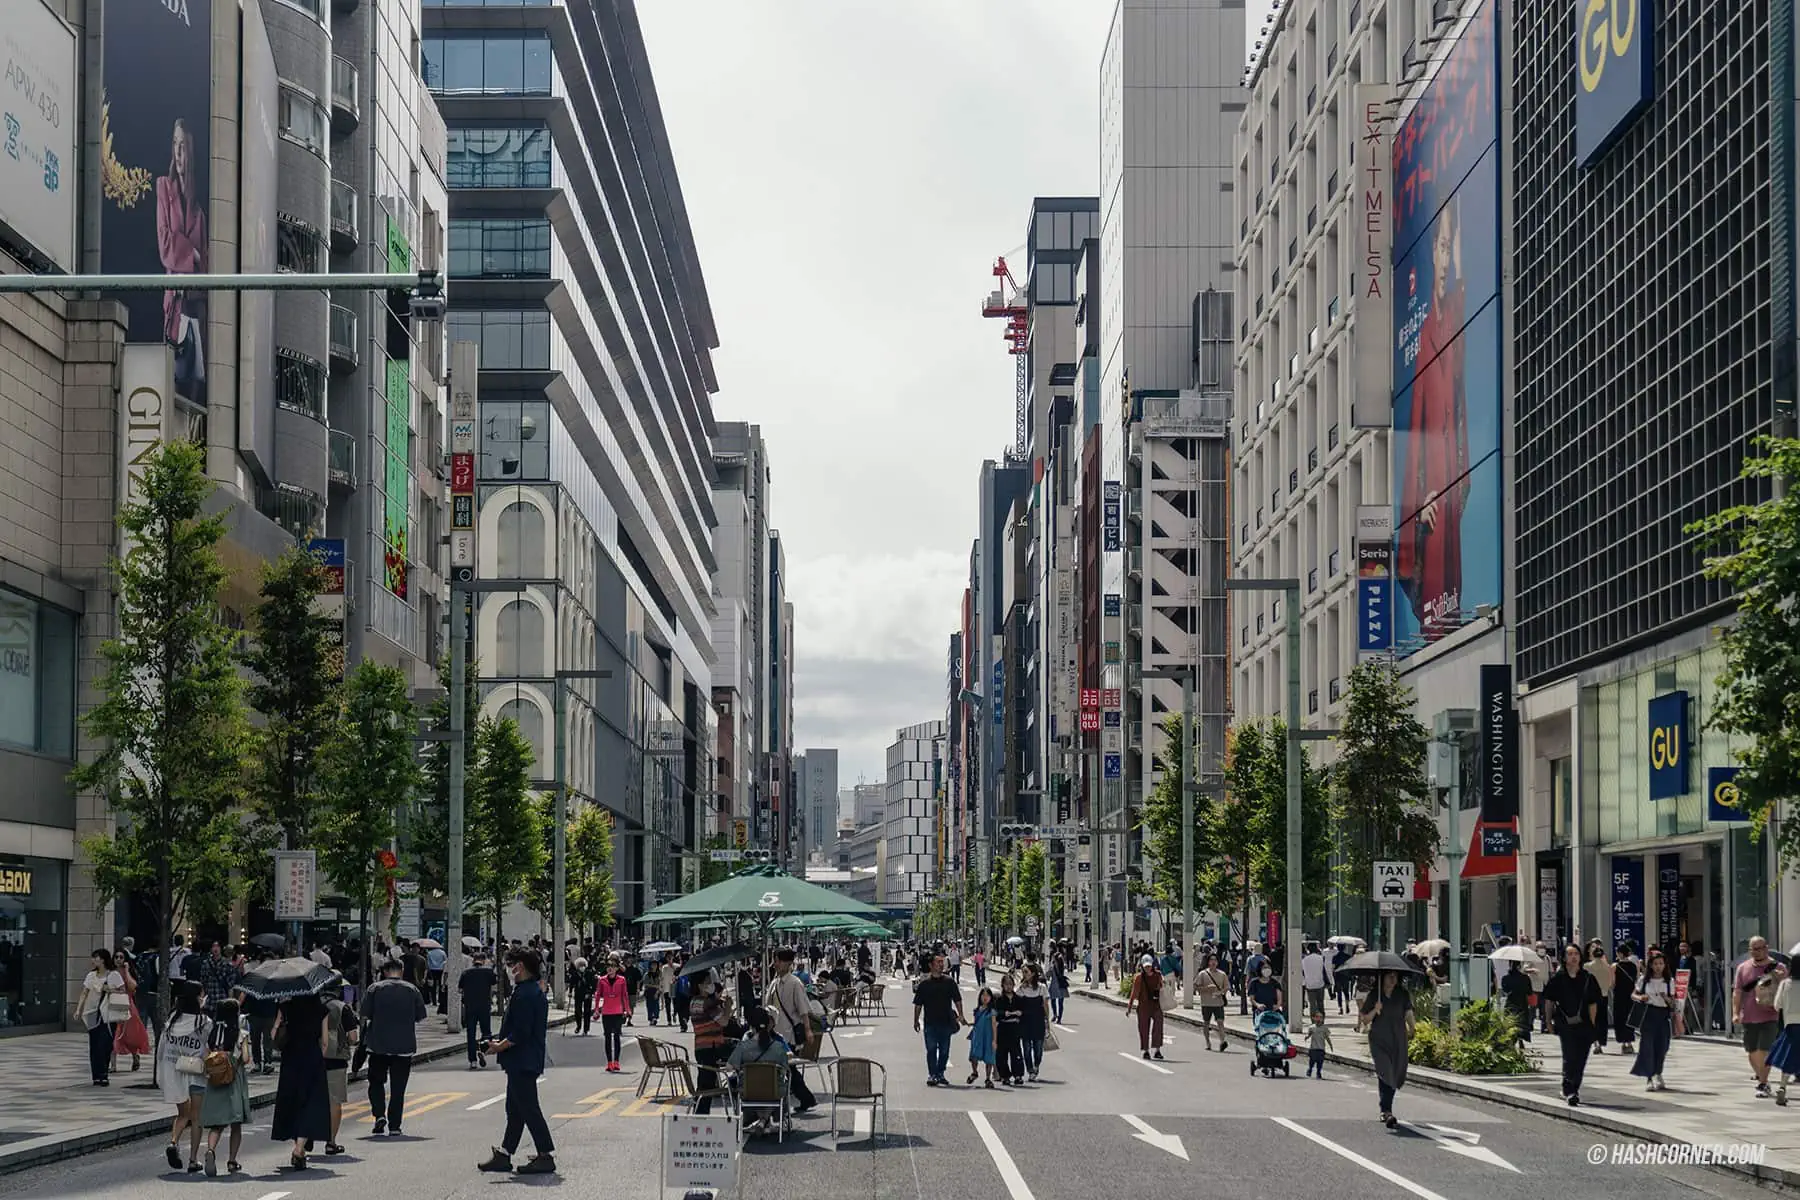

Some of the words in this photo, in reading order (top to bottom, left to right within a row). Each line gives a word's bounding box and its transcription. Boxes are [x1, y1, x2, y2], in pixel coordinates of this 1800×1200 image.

[1580, 0, 1636, 93] GU
[38, 92, 60, 129] 430
[1366, 103, 1382, 299] EXITMELSA
[456, 455, 470, 486] まつげ
[456, 497, 469, 527] 歯科
[1360, 549, 1389, 559] Seria
[1368, 586, 1382, 644] PLAZA
[1432, 586, 1459, 618] SoftBank
[1491, 691, 1504, 796] WASHINGTON
[1651, 724, 1679, 770] GU
[1484, 837, 1513, 845] ワシントン
[1378, 866, 1409, 876] TAXI
[1614, 872, 1630, 885] 5F
[1614, 900, 1630, 913] 4F
[1614, 928, 1630, 940] 3F
